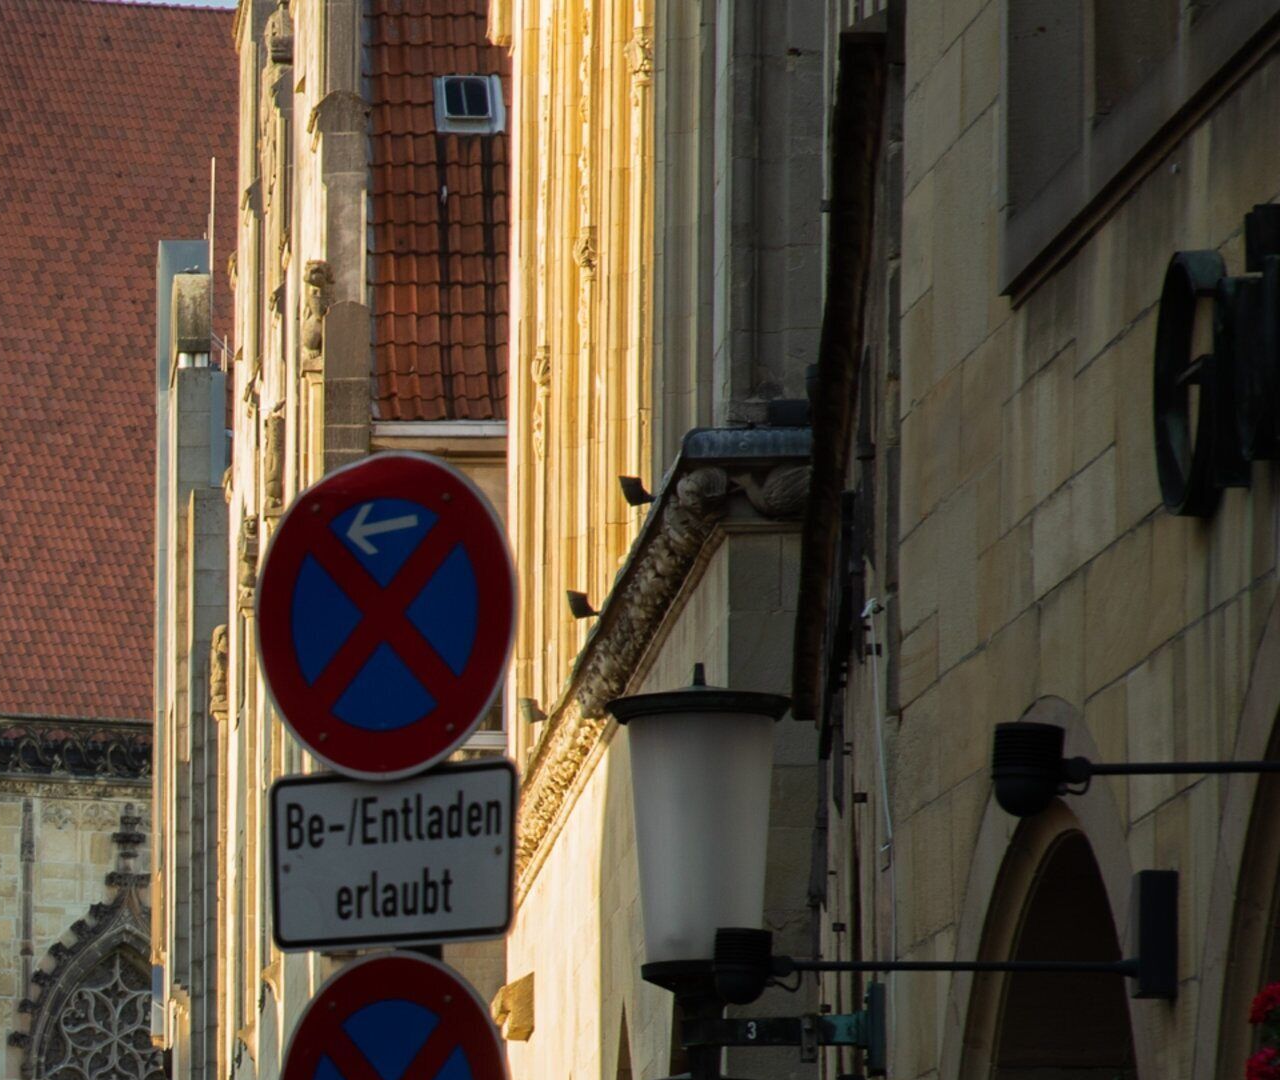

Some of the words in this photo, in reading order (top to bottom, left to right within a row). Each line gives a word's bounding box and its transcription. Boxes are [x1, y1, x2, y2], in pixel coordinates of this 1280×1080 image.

[287, 790, 503, 851] Be-/Entladen
[336, 867, 453, 921] erlaubt
[747, 1020, 757, 1040] 3
